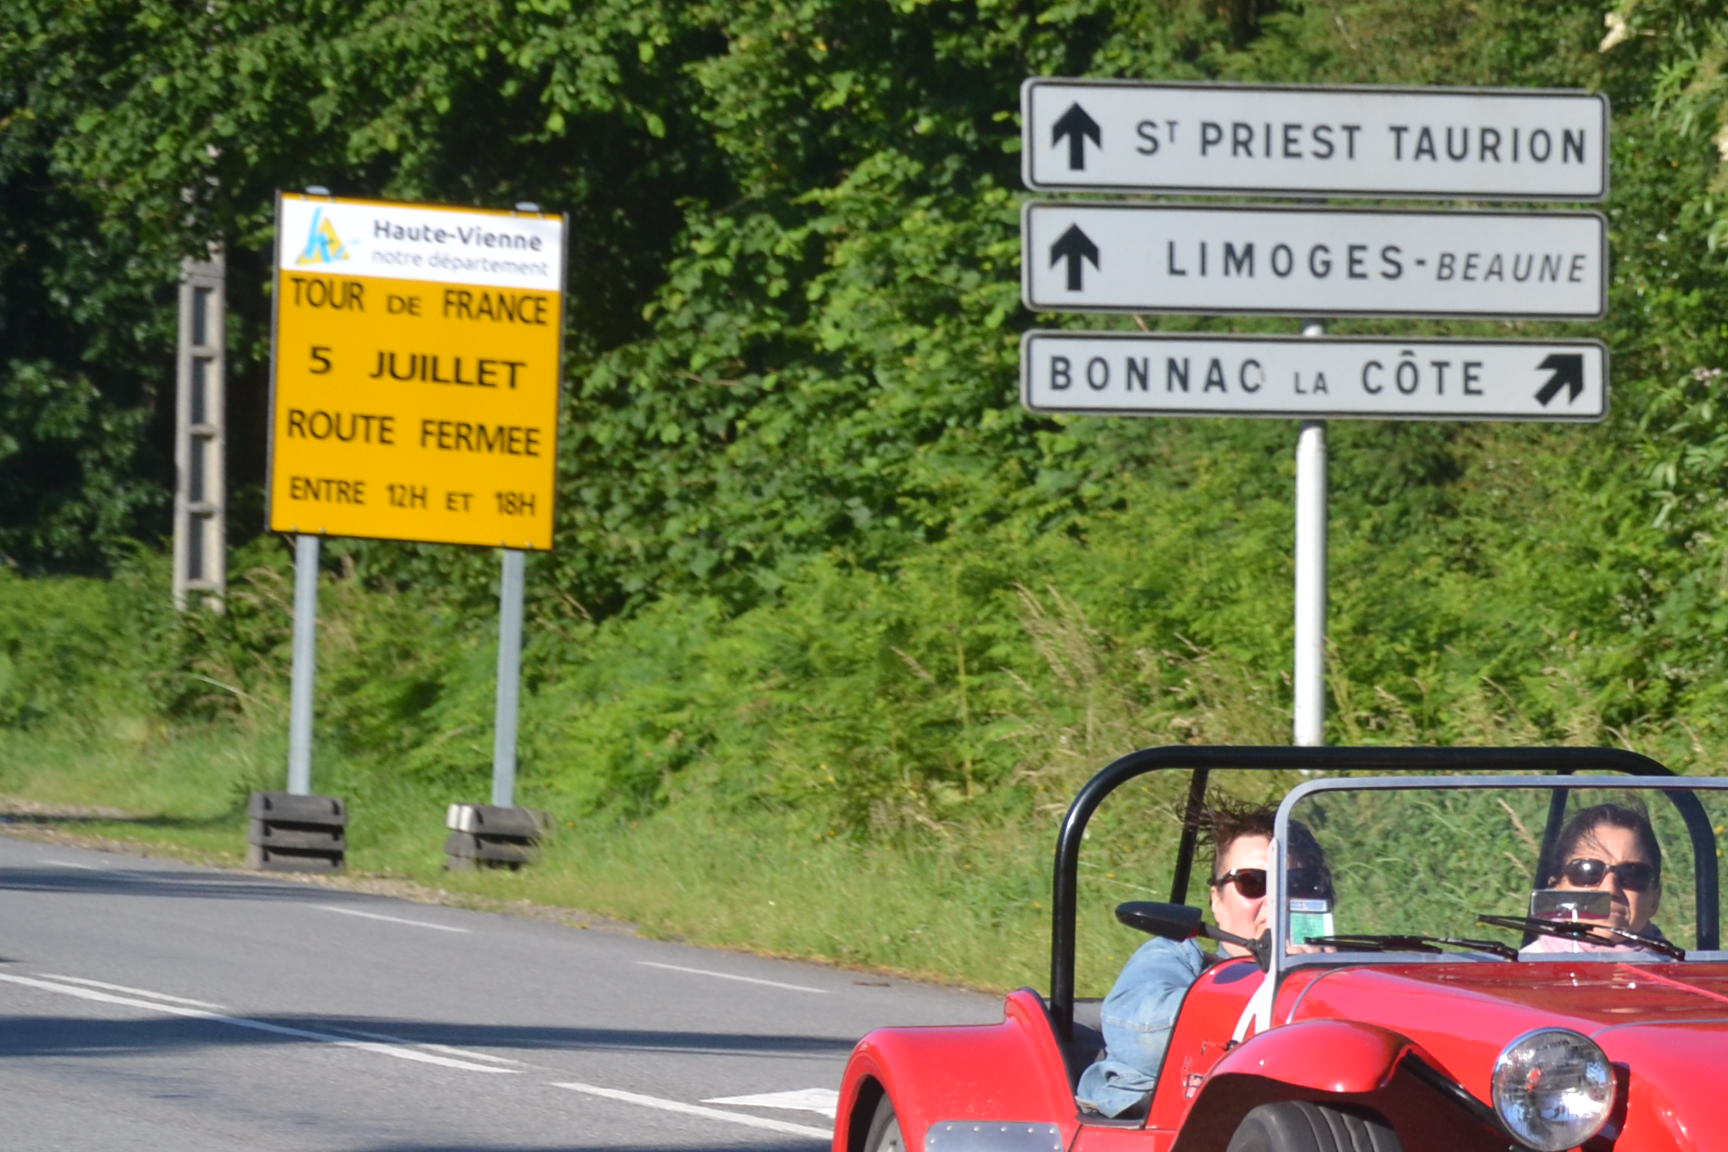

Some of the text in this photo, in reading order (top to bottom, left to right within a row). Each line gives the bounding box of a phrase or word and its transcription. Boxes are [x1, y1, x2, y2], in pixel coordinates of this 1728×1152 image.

[1200, 122, 1362, 159] PRIEST
[1389, 125, 1586, 165] TAURION
[373, 219, 543, 251] Haute-Vienne
[371, 249, 549, 277] notre département
[290, 277, 548, 326] TOUR DE FRANCE
[309, 346, 527, 389] 5 JUILLET
[1049, 349, 1485, 396] BONNAC LA CÔTE
[287, 408, 541, 457] ROUTE FERMEE
[290, 476, 536, 516] ENTRE 12H ET 18H
